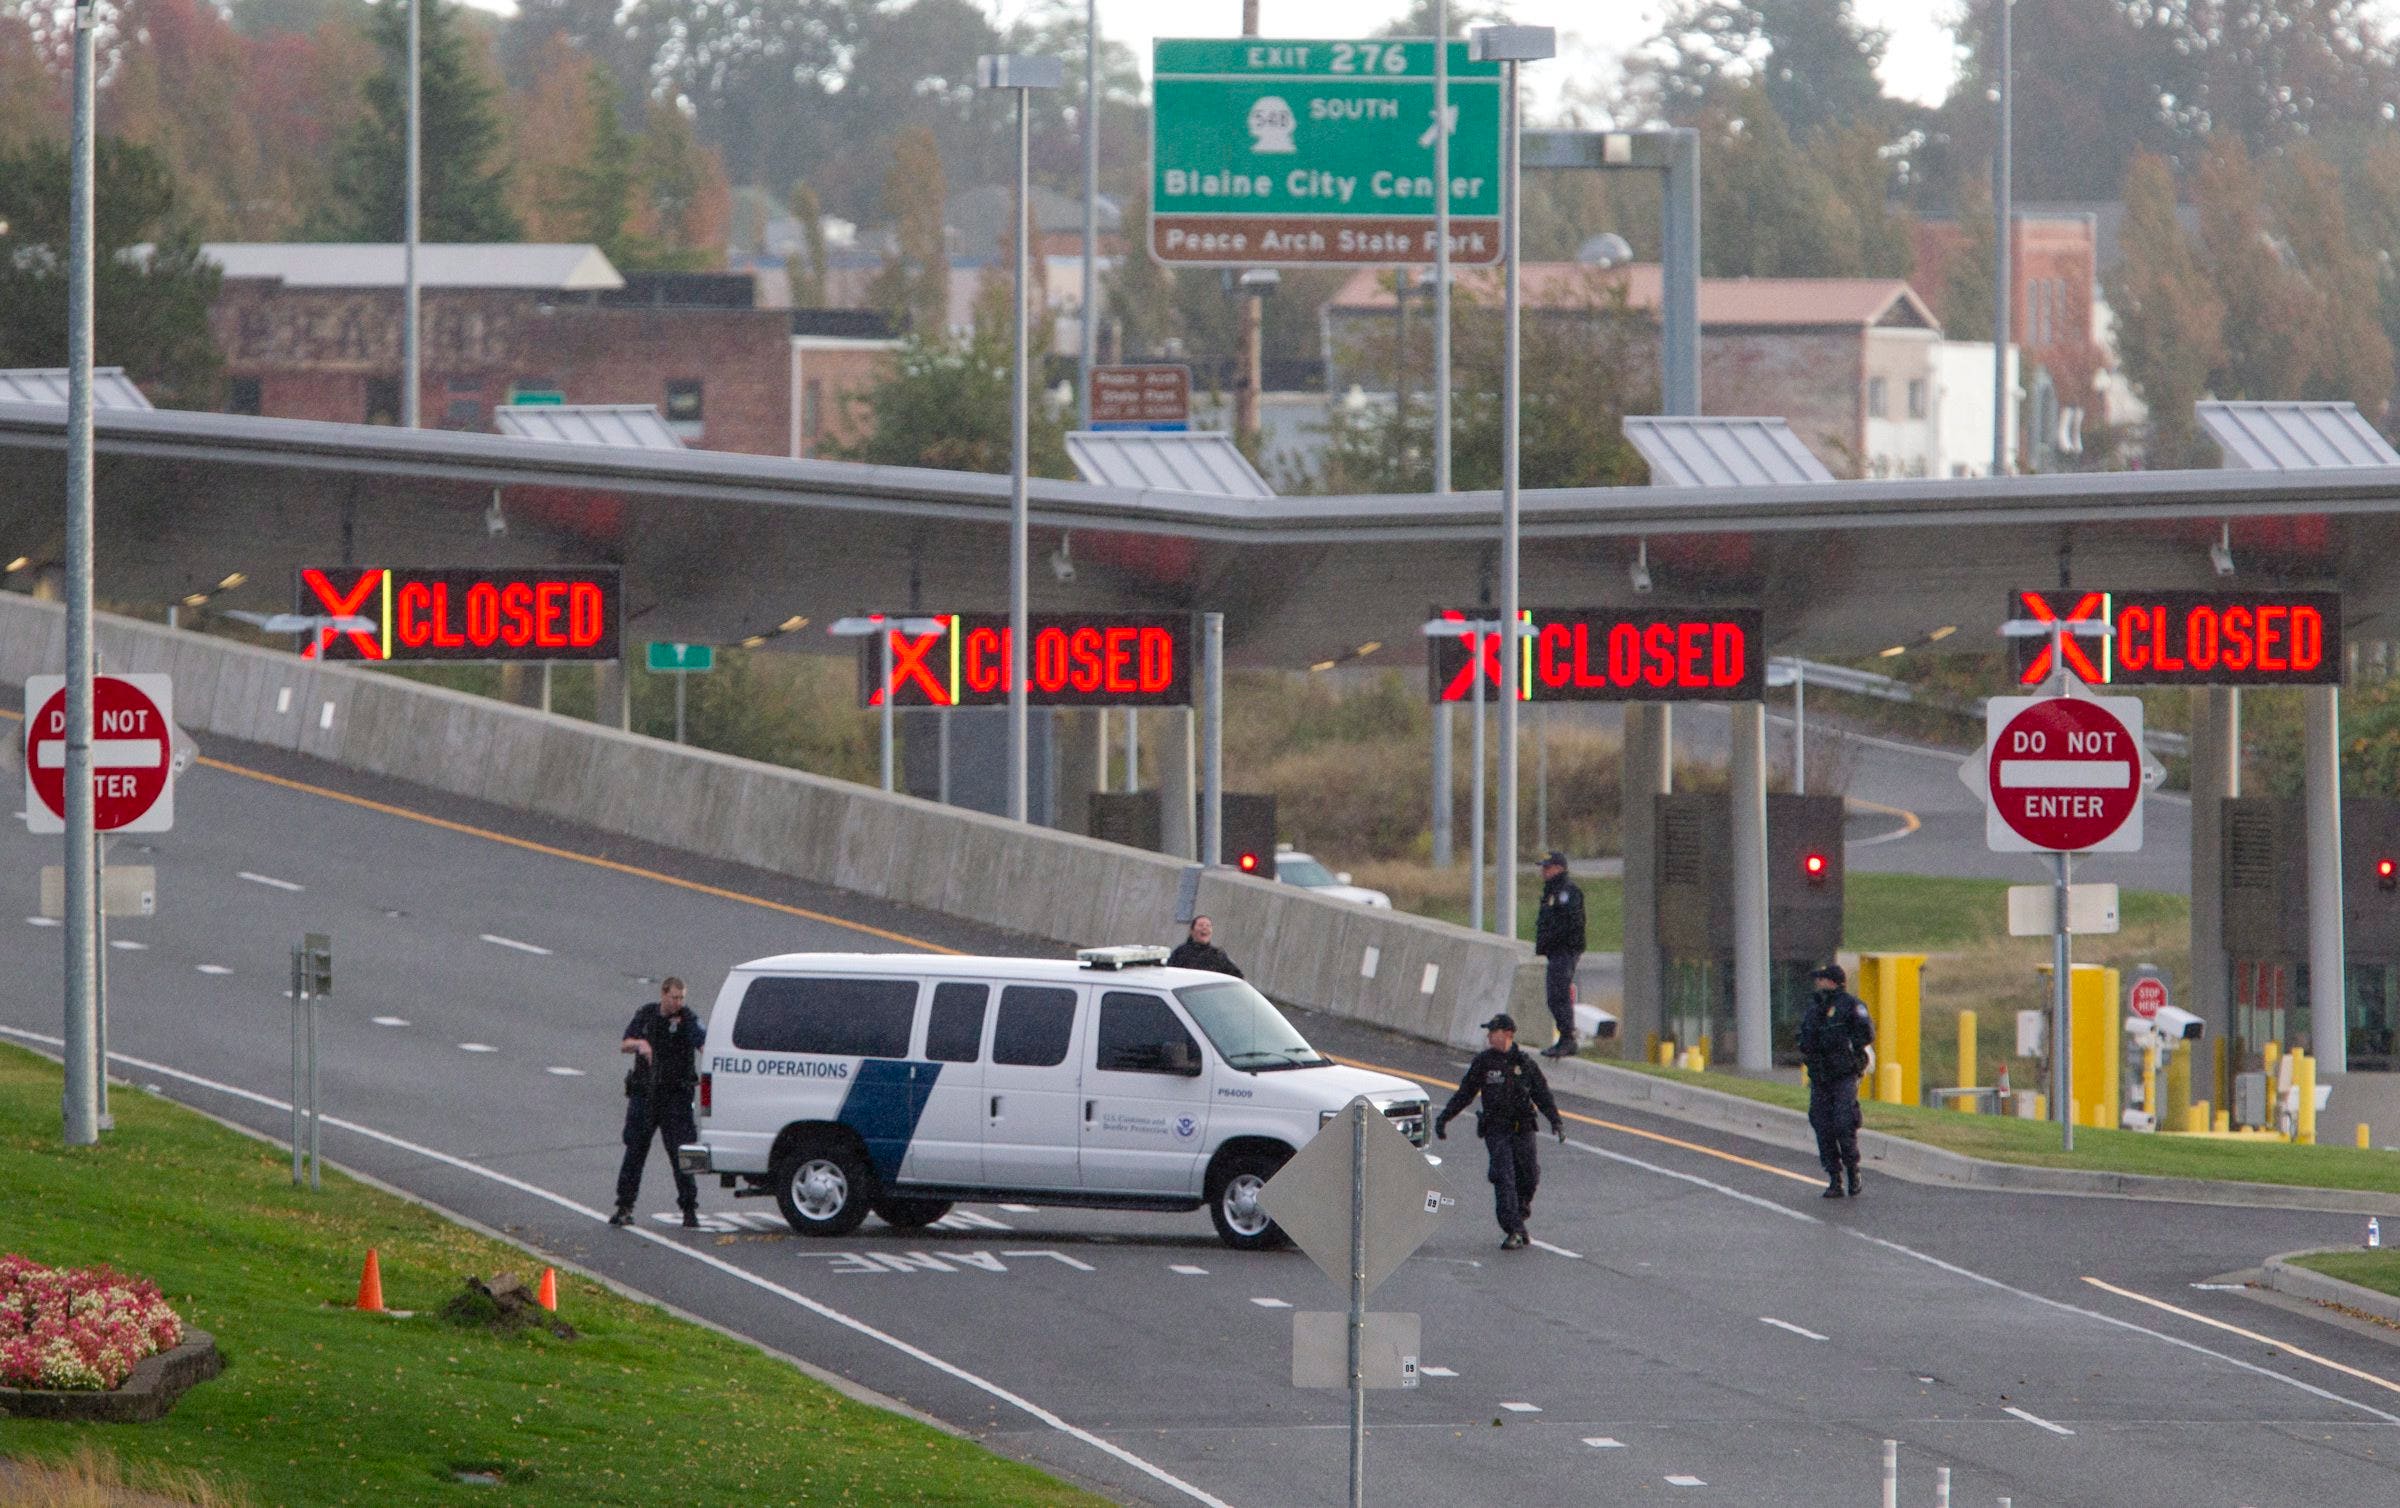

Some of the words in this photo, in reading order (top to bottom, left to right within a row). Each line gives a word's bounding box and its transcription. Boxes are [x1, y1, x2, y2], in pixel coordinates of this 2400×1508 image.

[1248, 47, 1311, 68] EXIT
[1329, 44, 1407, 73] 276
[1310, 99, 1399, 120] SOUTH
[1164, 169, 1273, 197] Blaine
[1287, 171, 1357, 204] City
[1371, 171, 1484, 199] Cener
[1166, 229, 1247, 251] Peace
[1261, 231, 1325, 251] Arch
[1338, 231, 1411, 252] State
[397, 582, 603, 647] CLOSED
[2117, 606, 2322, 671] CLOSED
[1539, 623, 1745, 688] CLOSED
[50, 711, 72, 733] D
[102, 710, 148, 733] NOT
[2013, 731, 2046, 753] DO
[2068, 732, 2117, 754] NOT
[62, 775, 137, 798] TER
[2025, 796, 2104, 818] ENTER
[2139, 987, 2160, 998] STOP
[712, 1057, 752, 1074] FIELD
[756, 1060, 848, 1078] OPERATIONS
[797, 1250, 1097, 1273] LANE
